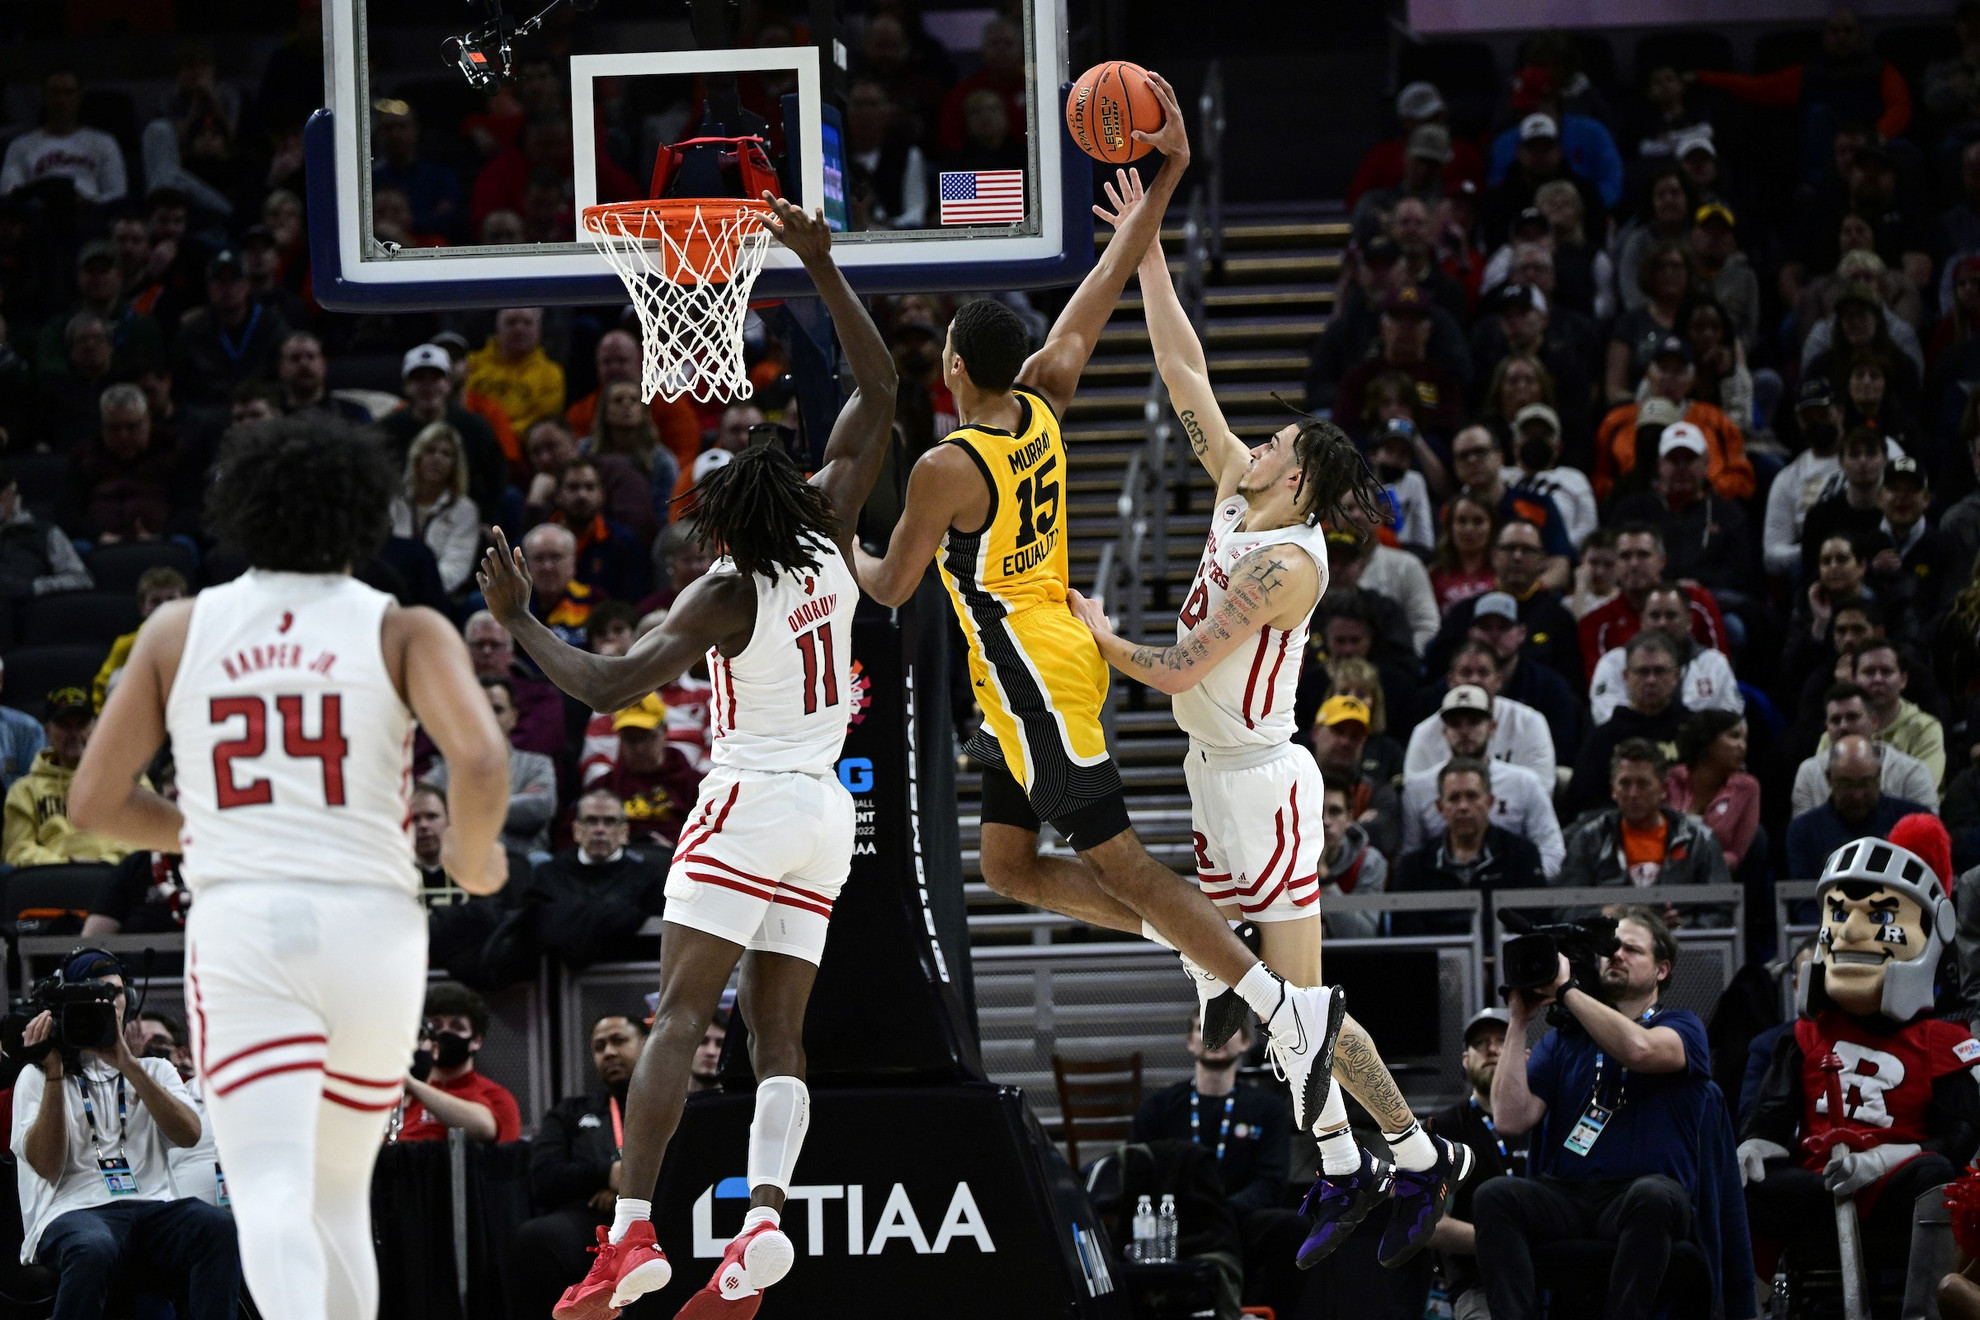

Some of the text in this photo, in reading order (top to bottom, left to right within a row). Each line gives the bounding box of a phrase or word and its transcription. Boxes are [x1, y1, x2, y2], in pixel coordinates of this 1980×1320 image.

[1075, 86, 1093, 152] SPALDING
[1101, 96, 1117, 152] LEGACY
[1007, 428, 1051, 475] MURRAY
[1015, 454, 1059, 549] 15
[222, 644, 302, 681] HARPER
[795, 621, 839, 715] 11
[209, 693, 349, 811] 24
[1884, 925, 1904, 943] R
[1815, 1040, 1905, 1129] R
[786, 1181, 996, 1256] TIAA
